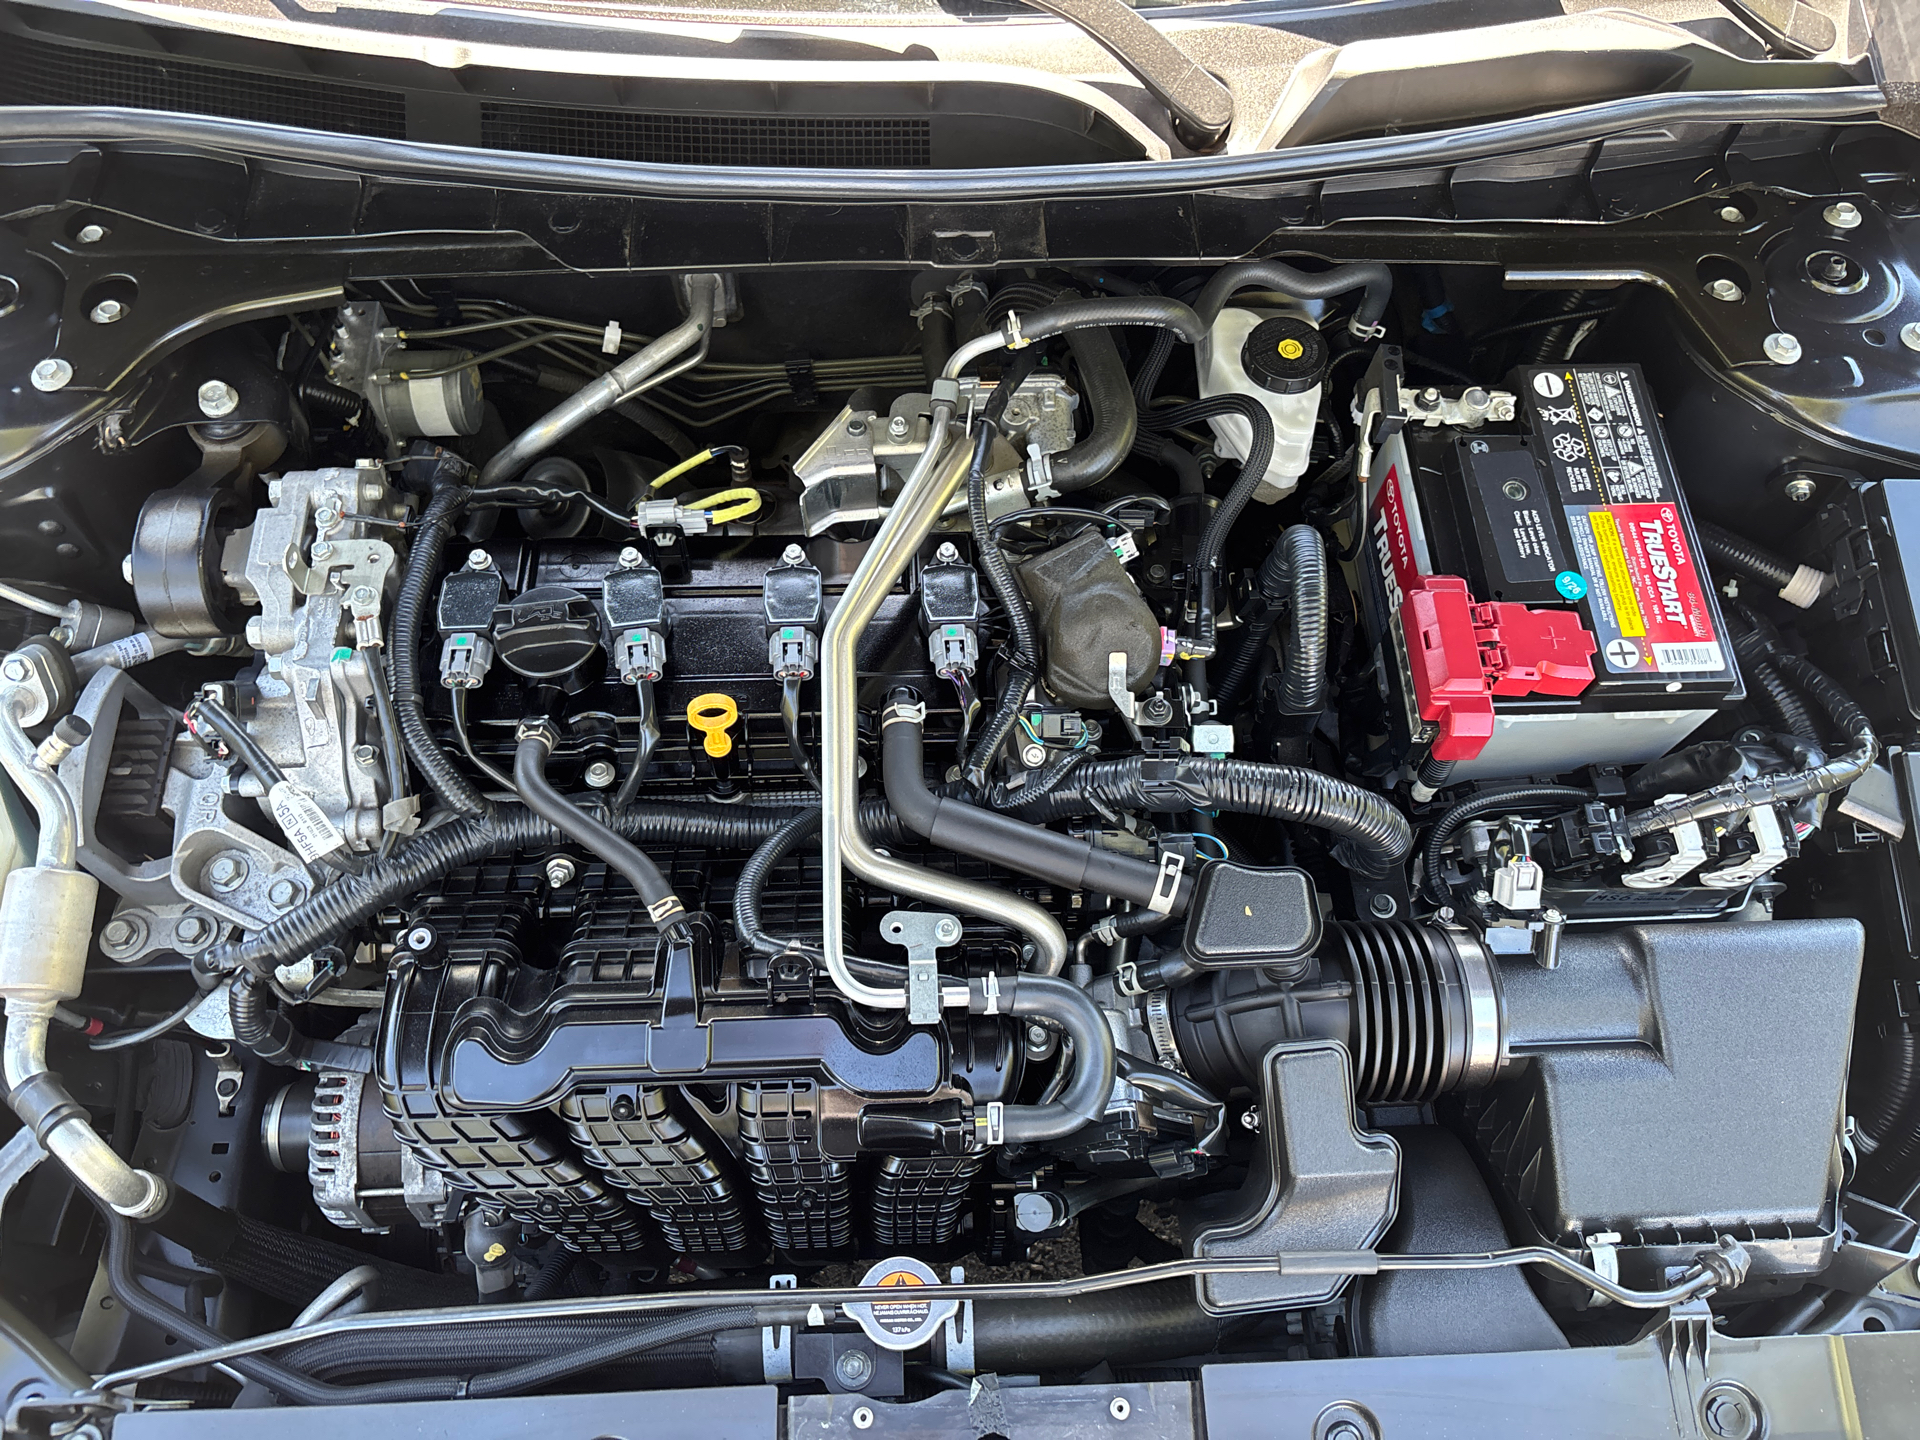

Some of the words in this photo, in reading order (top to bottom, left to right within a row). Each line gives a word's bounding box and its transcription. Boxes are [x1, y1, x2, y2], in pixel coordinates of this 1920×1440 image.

[1565, 466, 1578, 492] RECYCLED
[1572, 467, 1582, 482] MUST
[1579, 467, 1592, 490] BATTERY
[1531, 510, 1540, 523] ACID
[1613, 518, 1623, 532] Toyota
[1391, 501, 1409, 570] TOYOTA
[1520, 528, 1528, 542] Level
[1535, 523, 1545, 540] LEVEL
[1596, 530, 1604, 542] other
[1618, 533, 1627, 546] Motor
[1516, 539, 1526, 558] battery
[1528, 528, 1536, 541] Level
[1532, 542, 1540, 555] okay
[1665, 523, 1686, 564] TOYOTA
[1373, 506, 1403, 614] TRUES
[1541, 541, 1555, 571] INDICATOR
[1603, 554, 1611, 569] before
[1622, 547, 1630, 558] Sales
[1630, 556, 1642, 580] Distributed
[1563, 576, 1581, 595] 9/26
[1601, 529, 1611, 544] battery
[1611, 561, 1619, 577] ensure
[1619, 594, 1627, 605] plug
[1625, 617, 1634, 630] place
[1606, 571, 1618, 592] installing
[1619, 569, 1629, 589] attaches
[1629, 606, 1637, 616] side
[1602, 596, 1616, 628] INSTRUCTIONS
[1637, 602, 1646, 614] Texas
[1646, 586, 1655, 598] CCA
[1654, 615, 1662, 623] RC
[273, 799, 290, 816] 5A
[1595, 893, 1630, 901] MS6
